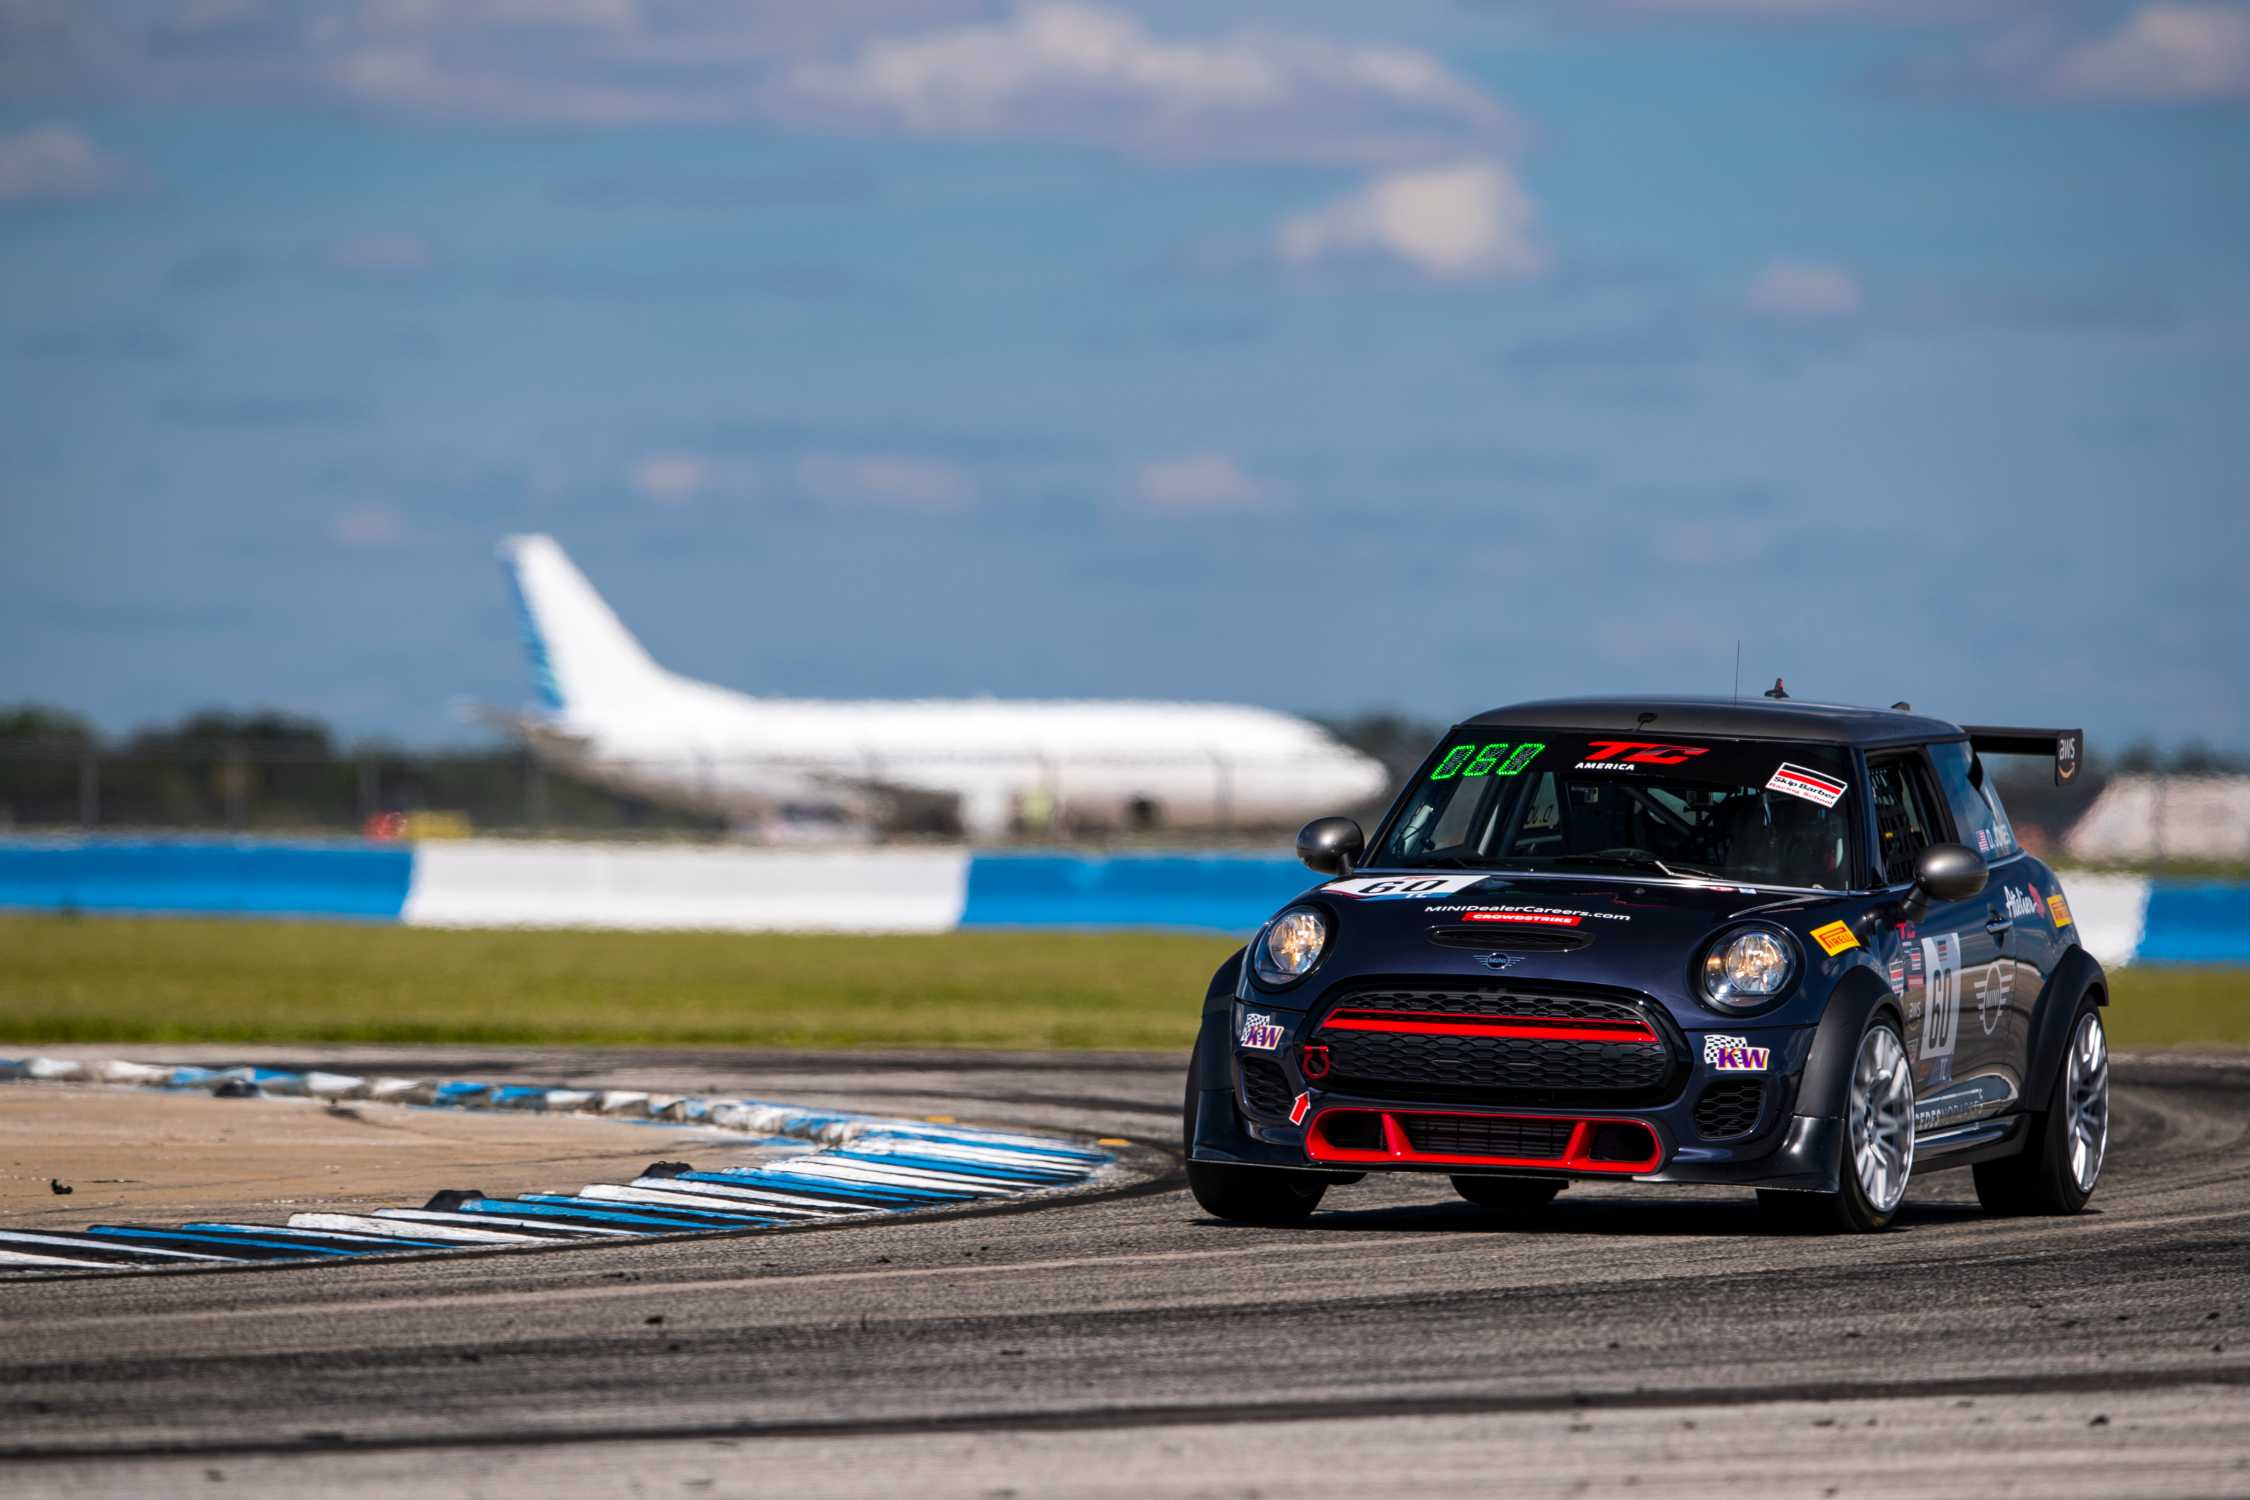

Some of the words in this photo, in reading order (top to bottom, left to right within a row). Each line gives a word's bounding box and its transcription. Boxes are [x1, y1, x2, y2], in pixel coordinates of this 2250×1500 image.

[1584, 740, 1711, 765] TC
[2059, 737, 2076, 761] aws
[1430, 743, 1547, 780] 060
[1574, 762, 1635, 771] AMERICA
[1768, 782, 1800, 795] Racing
[1773, 775, 1799, 788] Skip
[1799, 783, 1838, 800] Barber
[1357, 879, 1449, 894] 60
[1424, 905, 1632, 921] MINIDealerCareers.com
[1472, 913, 1573, 924] CROWDSTRIKE
[1818, 926, 1856, 949] PIRELLI
[1928, 967, 1952, 1050] 60
[1244, 1025, 1283, 1048] KW
[1717, 1046, 1769, 1069] KW
